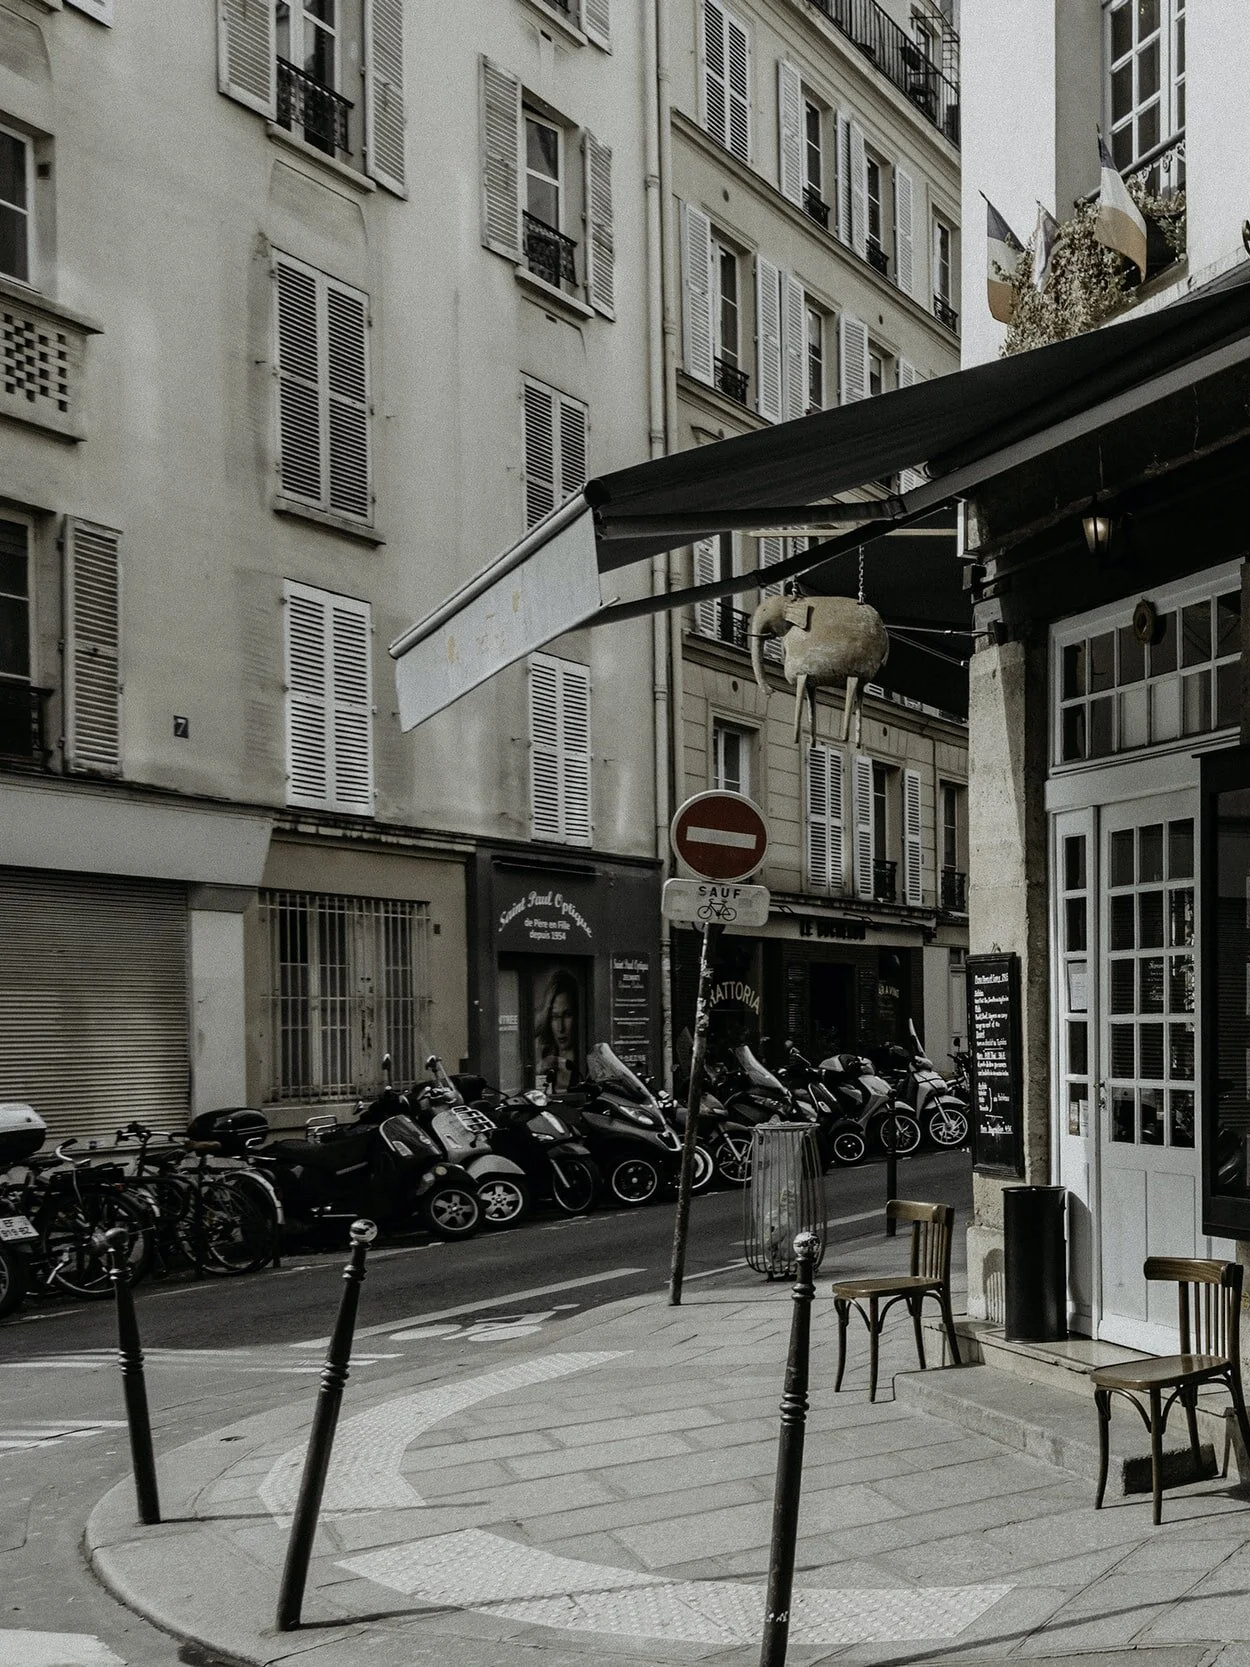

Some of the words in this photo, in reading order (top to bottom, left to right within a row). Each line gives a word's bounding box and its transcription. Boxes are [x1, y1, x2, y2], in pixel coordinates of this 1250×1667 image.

[698, 886, 742, 899] SAUF
[498, 897, 526, 932] Saint
[527, 890, 553, 908] Paul
[554, 893, 593, 938] Optique
[524, 918, 533, 927] de
[549, 921, 557, 929] en
[529, 929, 551, 940] depuis
[708, 980, 760, 1016] RATTORIA
